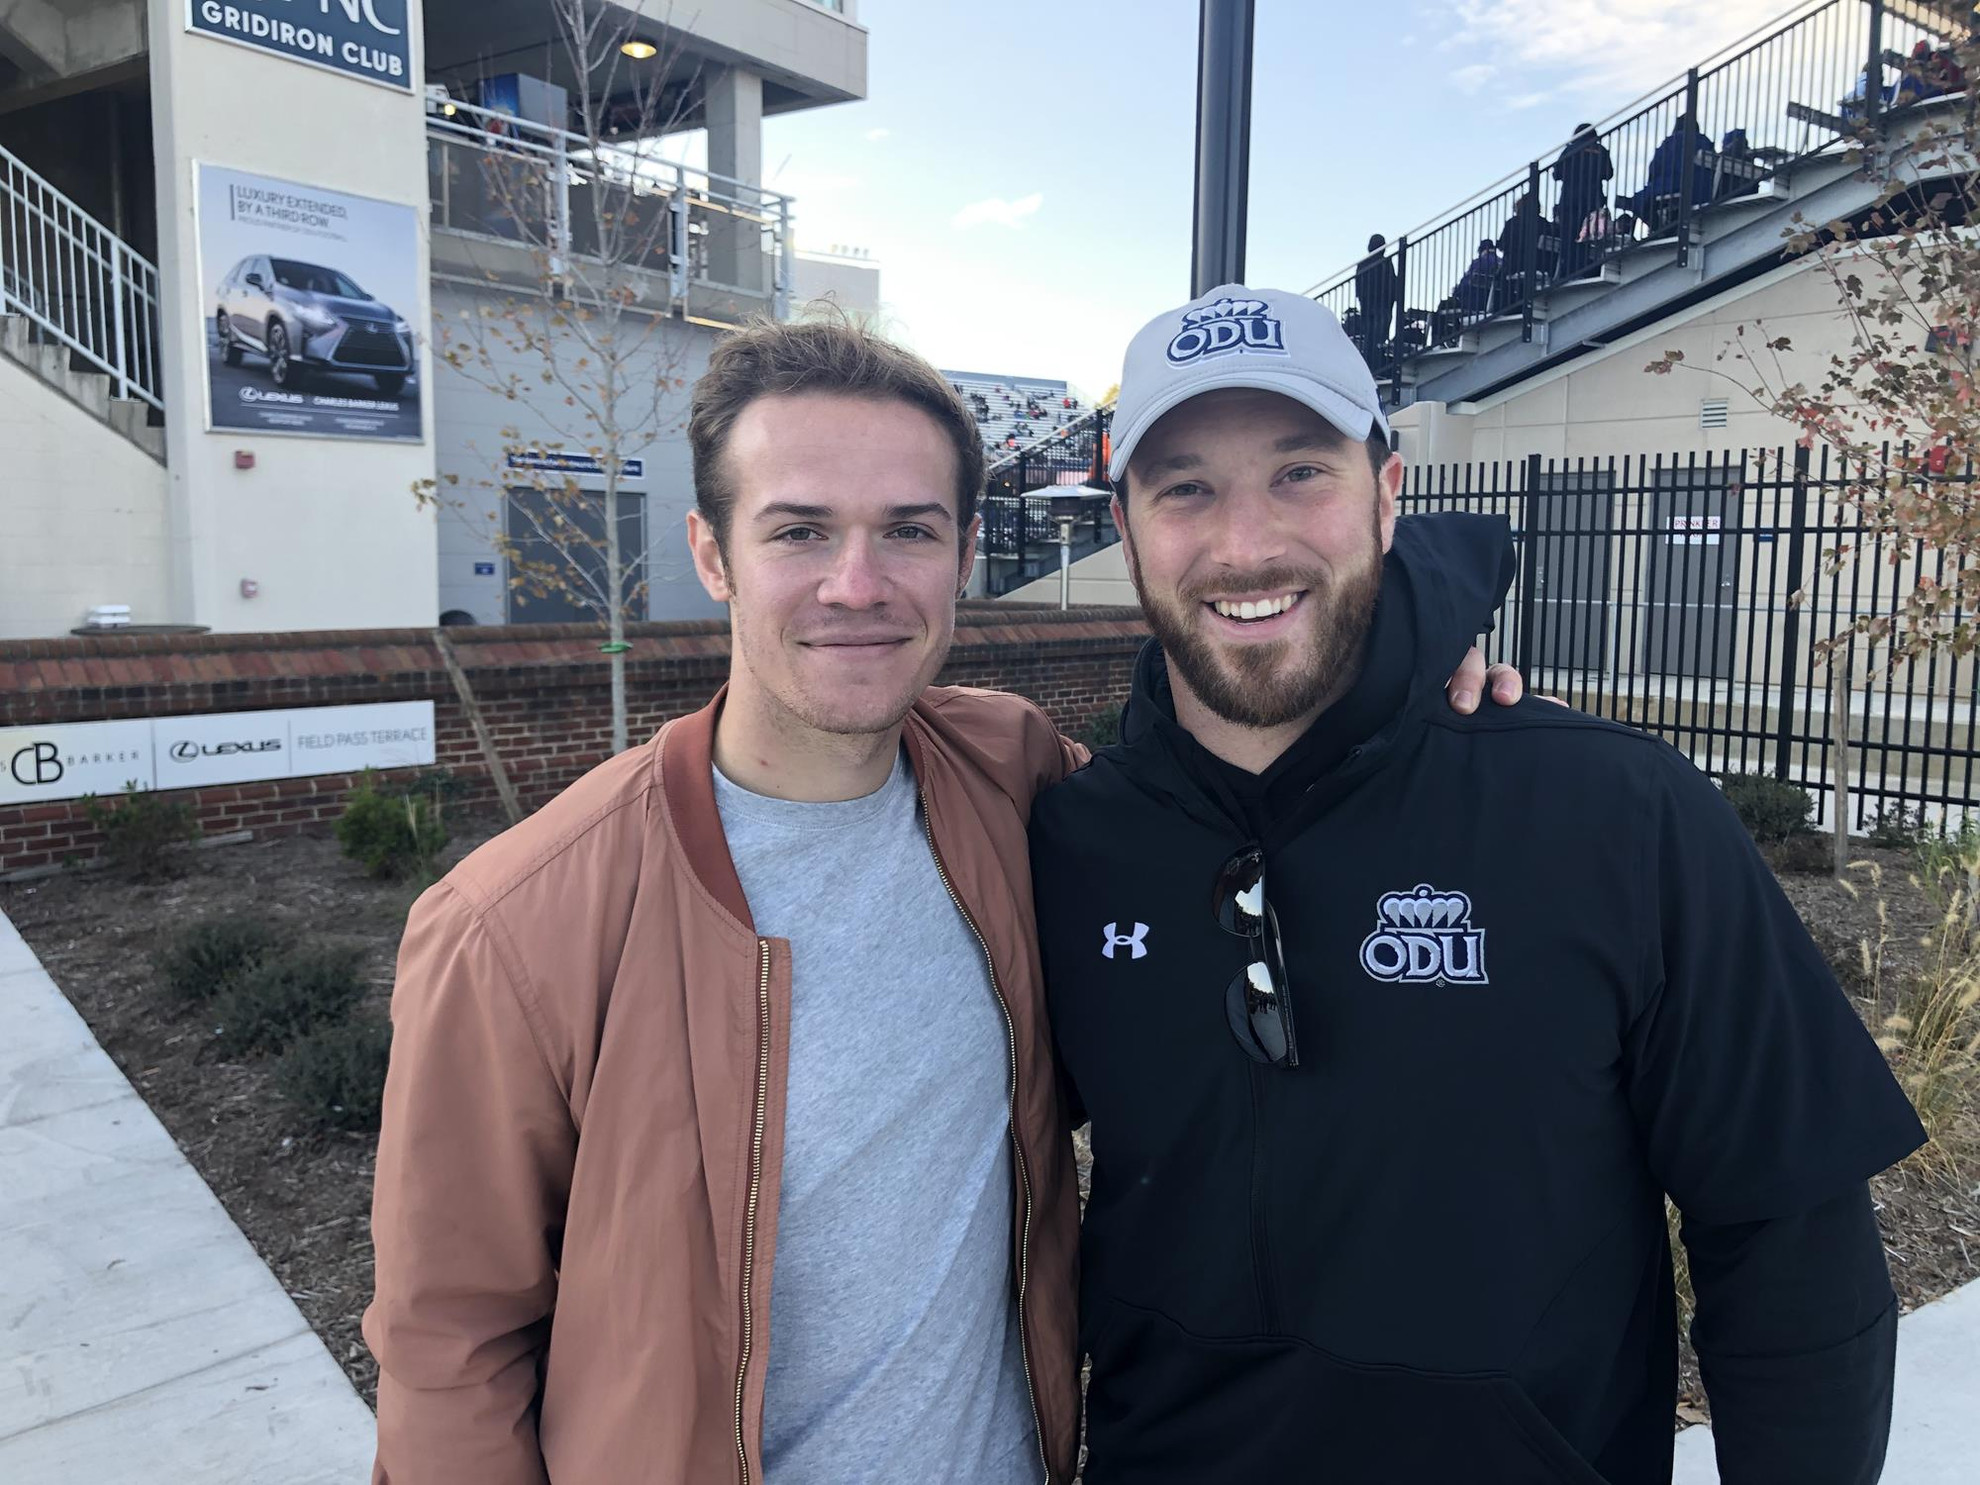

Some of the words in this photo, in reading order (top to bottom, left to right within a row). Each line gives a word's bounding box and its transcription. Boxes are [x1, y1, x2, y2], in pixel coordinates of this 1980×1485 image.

[201, 0, 334, 56] GRIDIRON
[341, 42, 403, 76] CLUB
[236, 185, 285, 206] LUXURY
[237, 200, 253, 213] BY
[255, 204, 263, 215] A
[264, 206, 299, 223] THIRD
[301, 213, 330, 228] ROW
[1167, 317, 1285, 363] ODU
[202, 738, 282, 757] LEXUS
[298, 733, 335, 750] FIELD
[336, 730, 369, 747] PASS
[370, 727, 427, 745] TERRACE
[66, 750, 140, 766] BARKER
[1365, 933, 1482, 978] ODU
